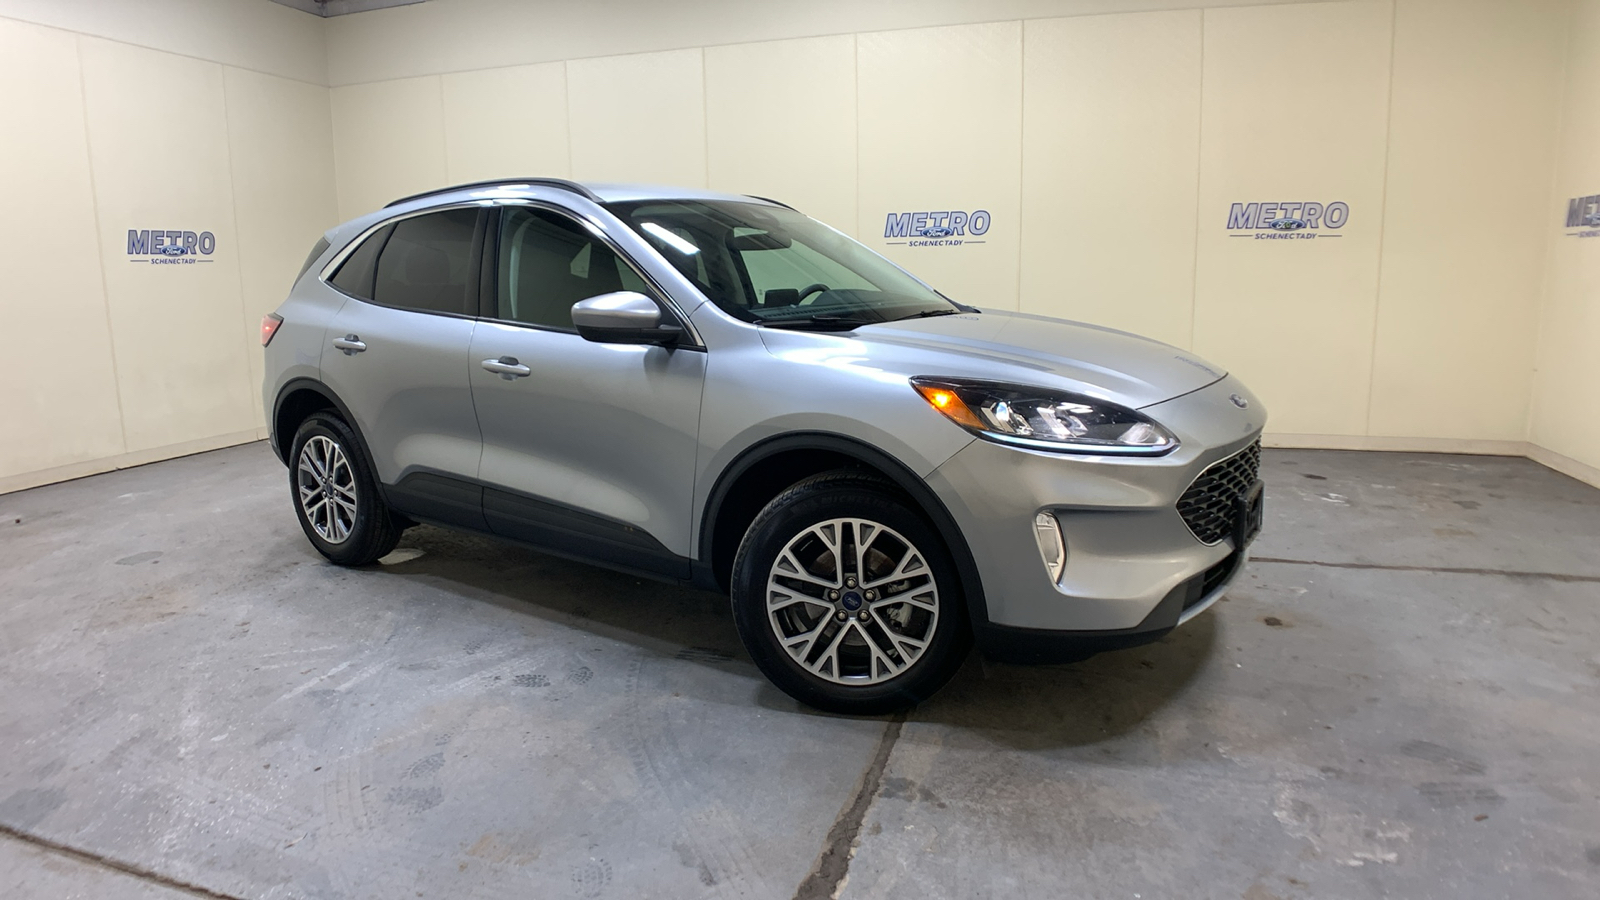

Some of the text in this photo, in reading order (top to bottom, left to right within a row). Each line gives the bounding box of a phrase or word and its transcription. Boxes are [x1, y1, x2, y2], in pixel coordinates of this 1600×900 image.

[884, 210, 991, 238] METRO
[1226, 201, 1350, 229] METRO
[127, 229, 216, 255] METRO
[908, 239, 964, 247] SCHENECTADY
[1254, 232, 1317, 240] SCHENECTADY
